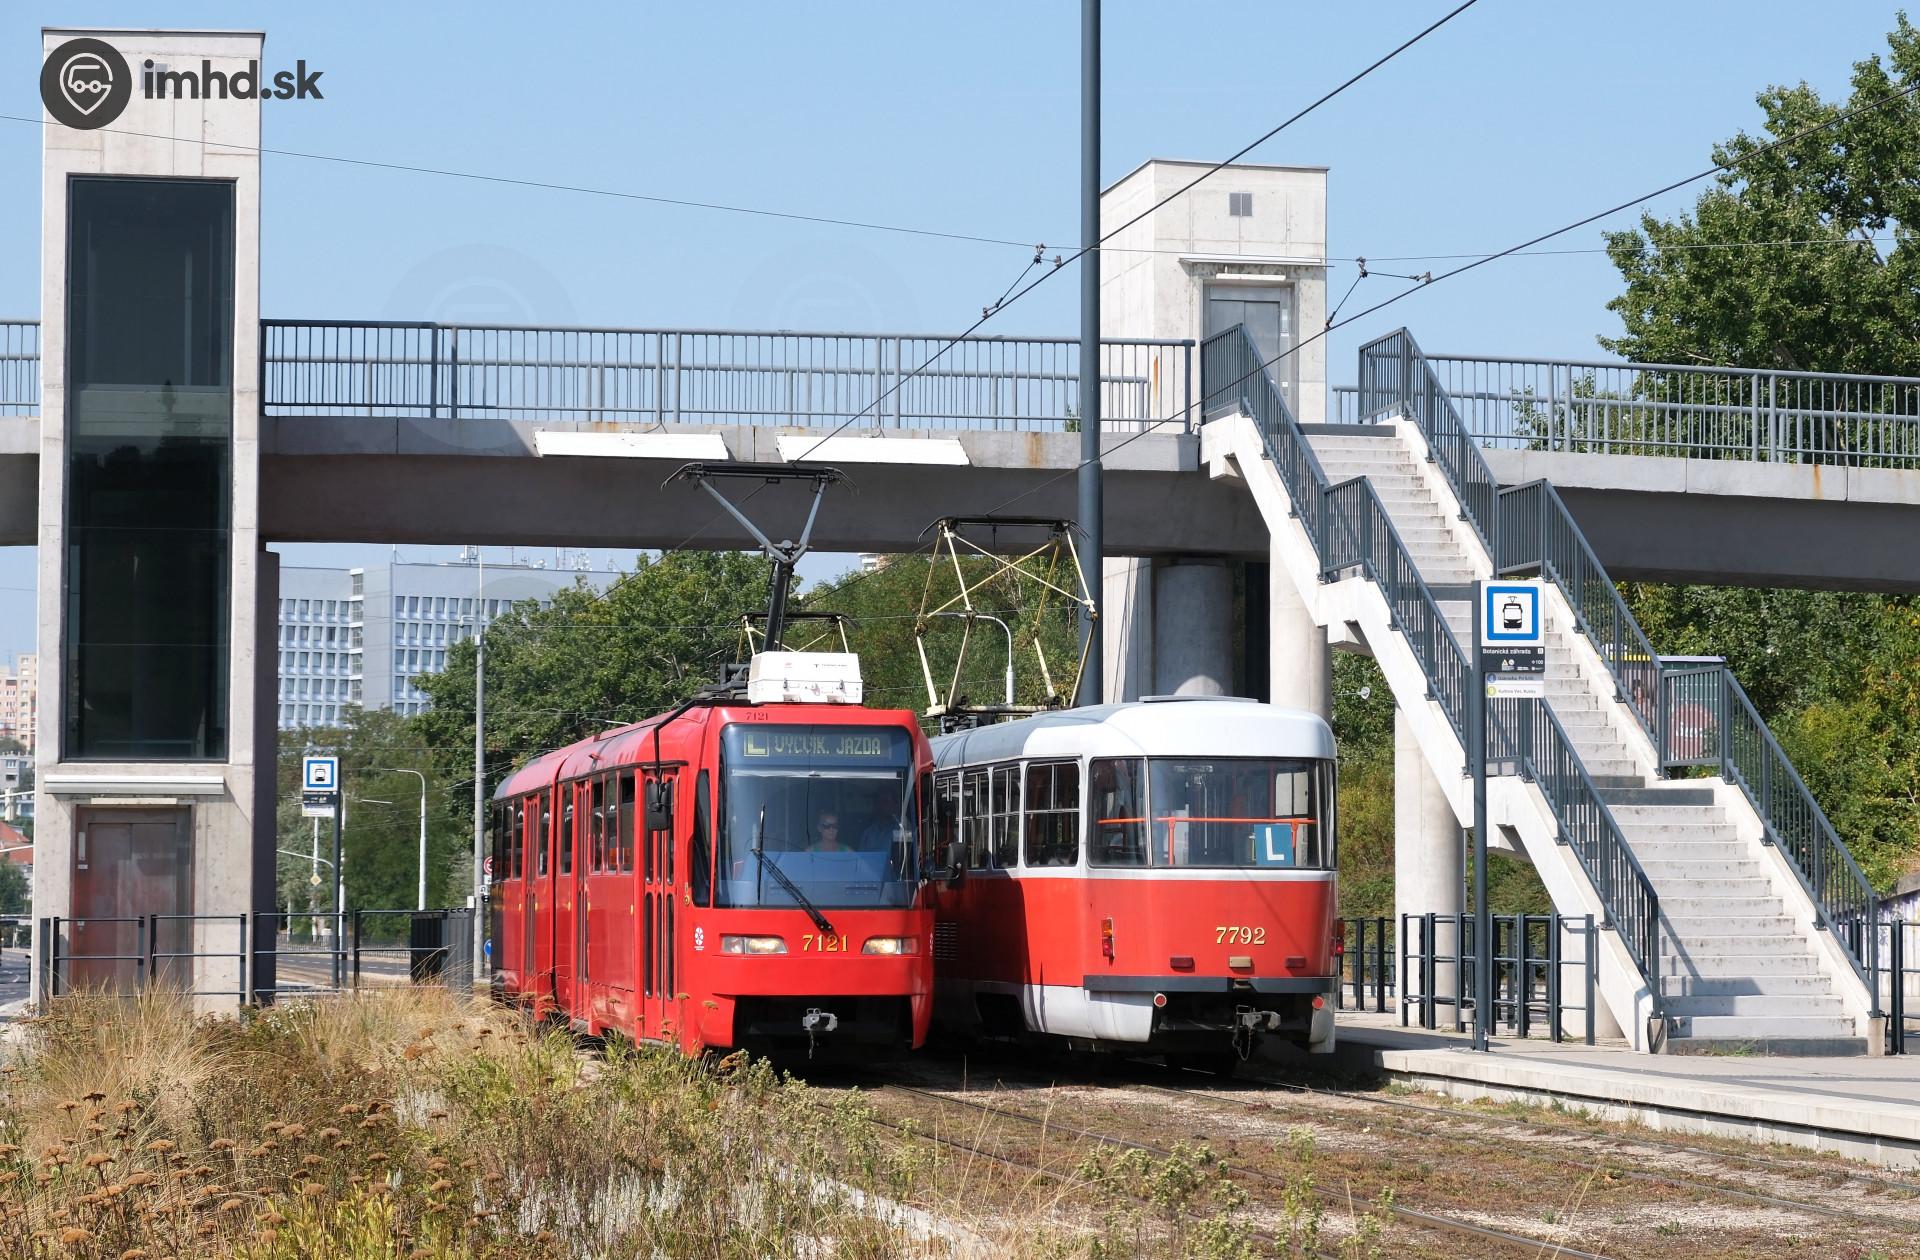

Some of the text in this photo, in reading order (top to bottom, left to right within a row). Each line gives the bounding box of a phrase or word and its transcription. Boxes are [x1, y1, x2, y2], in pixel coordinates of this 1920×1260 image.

[745, 712, 768, 721] 7121
[836, 737, 881, 755] JAZDA
[1265, 827, 1285, 861] L
[802, 934, 849, 952] 7121
[1215, 926, 1266, 945] 7792
